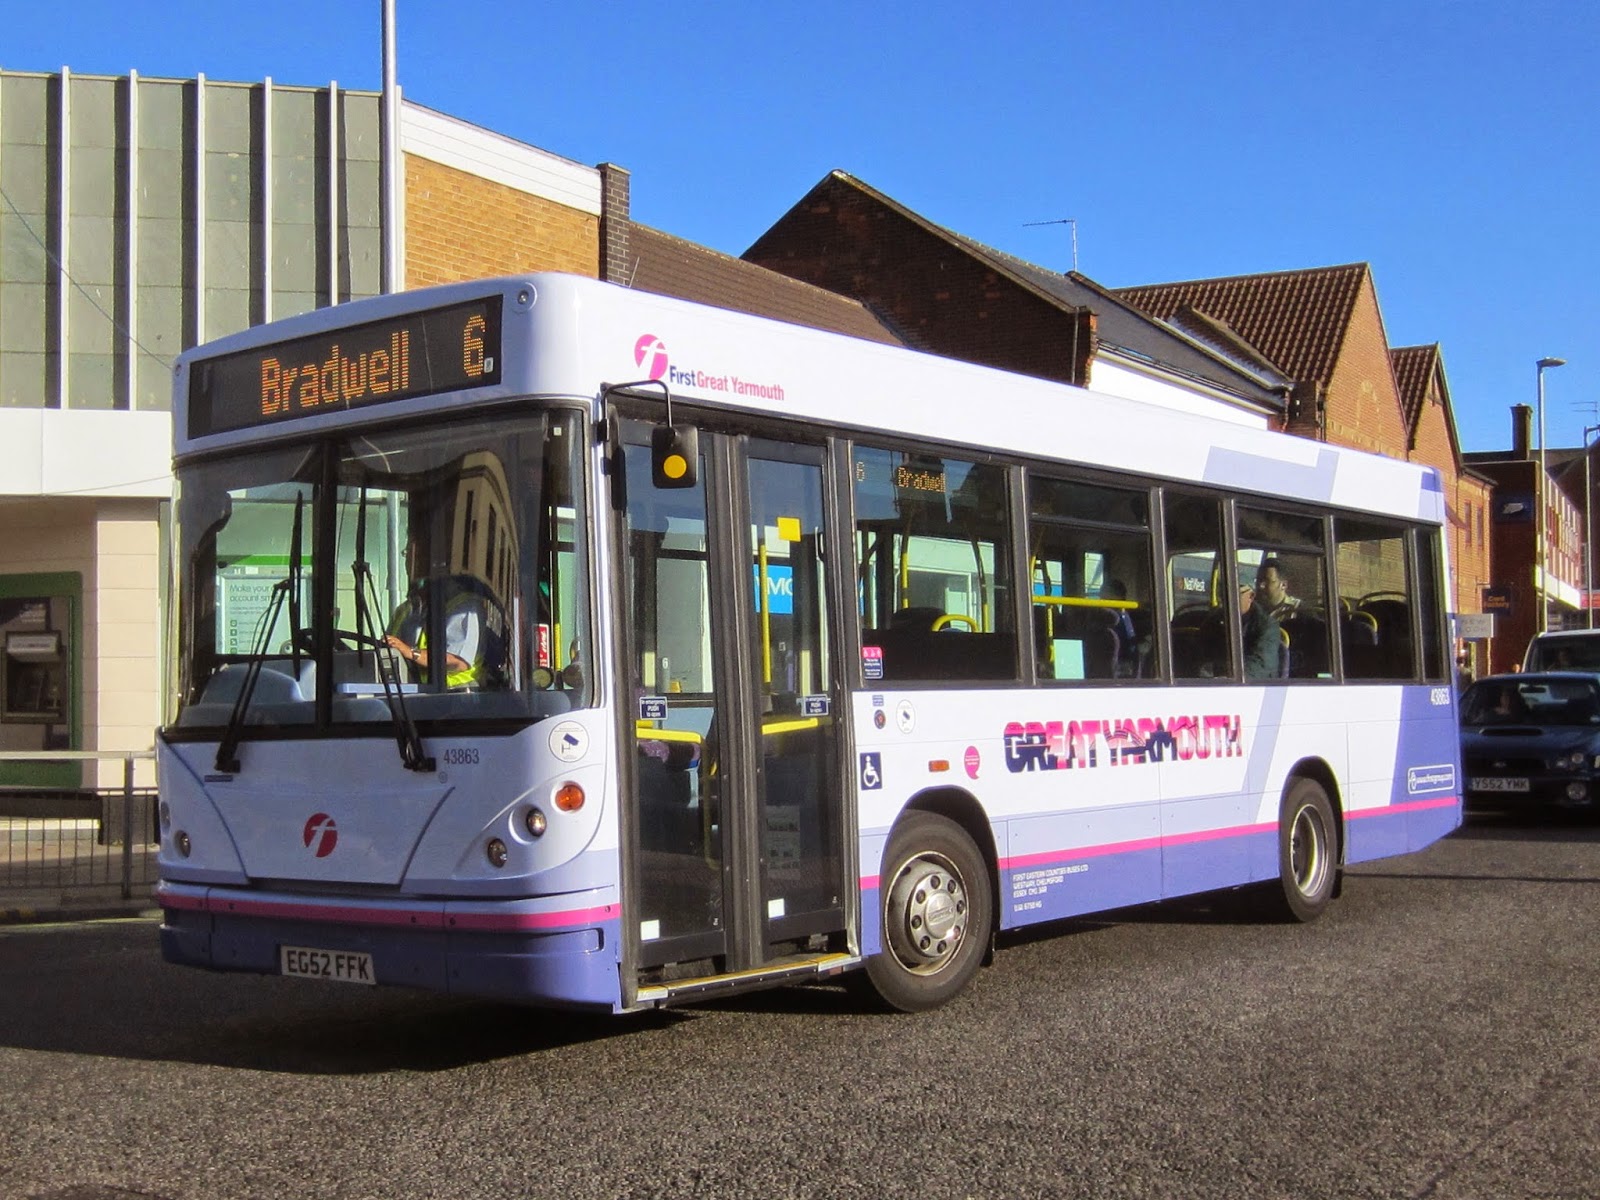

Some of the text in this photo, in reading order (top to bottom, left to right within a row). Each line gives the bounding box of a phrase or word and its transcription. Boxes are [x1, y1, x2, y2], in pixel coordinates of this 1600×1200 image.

[262, 314, 486, 415] Bradwell 6
[731, 376, 785, 400] Yarmouth
[898, 467, 946, 492] Bradwell
[252, 585, 269, 594] your
[662, 657, 669, 669] 6
[1431, 688, 1450, 705] 43863
[444, 749, 480, 764] 43863
[1013, 864, 1089, 881] FIRST EASTERN COUNTIES BUSES LTD
[1013, 889, 1027, 898] ESSEX
[287, 950, 369, 980] EG52 FFK
